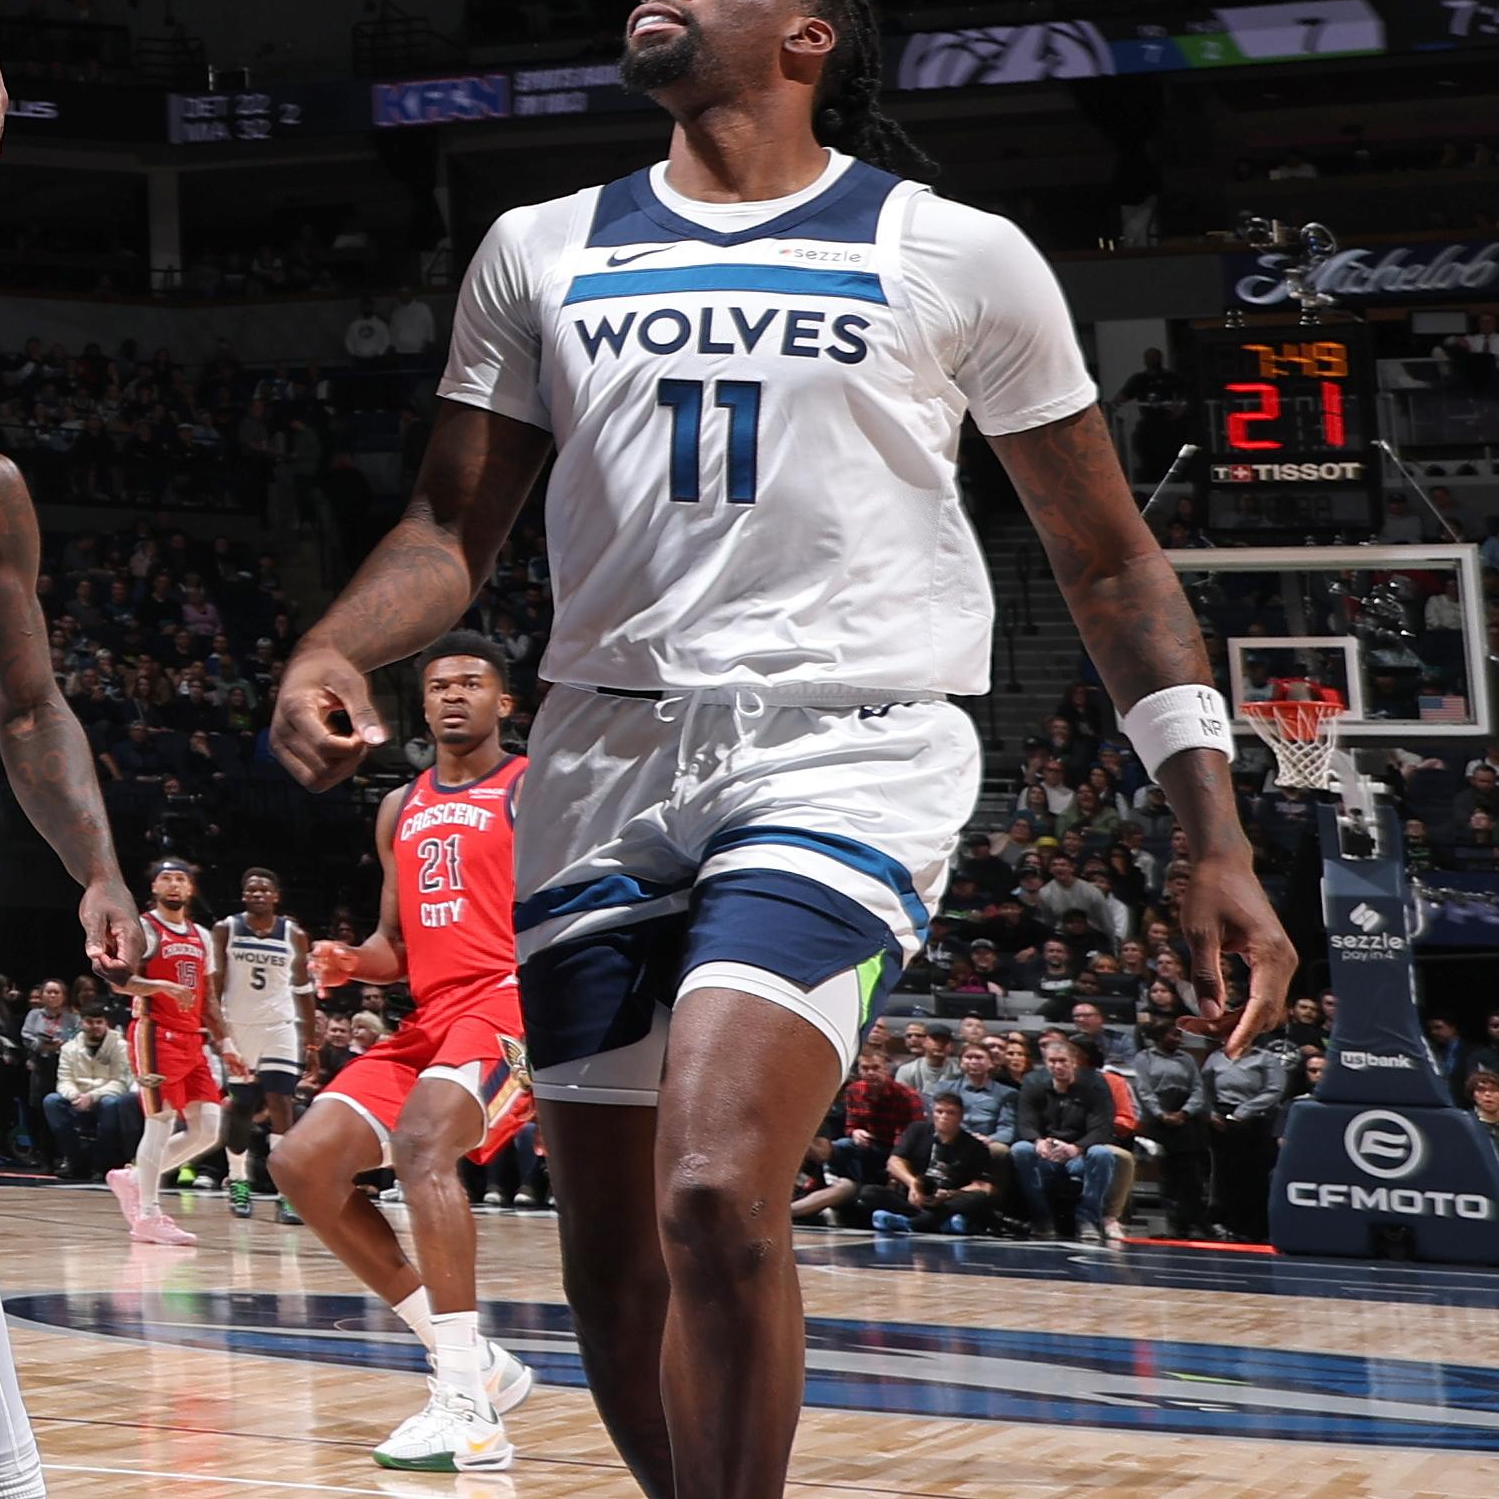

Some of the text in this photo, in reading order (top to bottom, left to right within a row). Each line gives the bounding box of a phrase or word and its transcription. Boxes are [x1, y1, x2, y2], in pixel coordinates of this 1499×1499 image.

[794, 247, 861, 264] sezzle
[575, 307, 871, 365] WOLVES
[1223, 381, 1347, 451] 21
[657, 378, 762, 504] 11
[1252, 462, 1366, 482] TISSOT
[400, 802, 496, 843] CRESCENT
[417, 833, 465, 894] 21
[420, 898, 466, 929] CITY
[1330, 931, 1403, 950] sezzle
[233, 951, 286, 967] WOLVES
[250, 967, 267, 990] 5
[1285, 1180, 1492, 1220] CFMOTO
